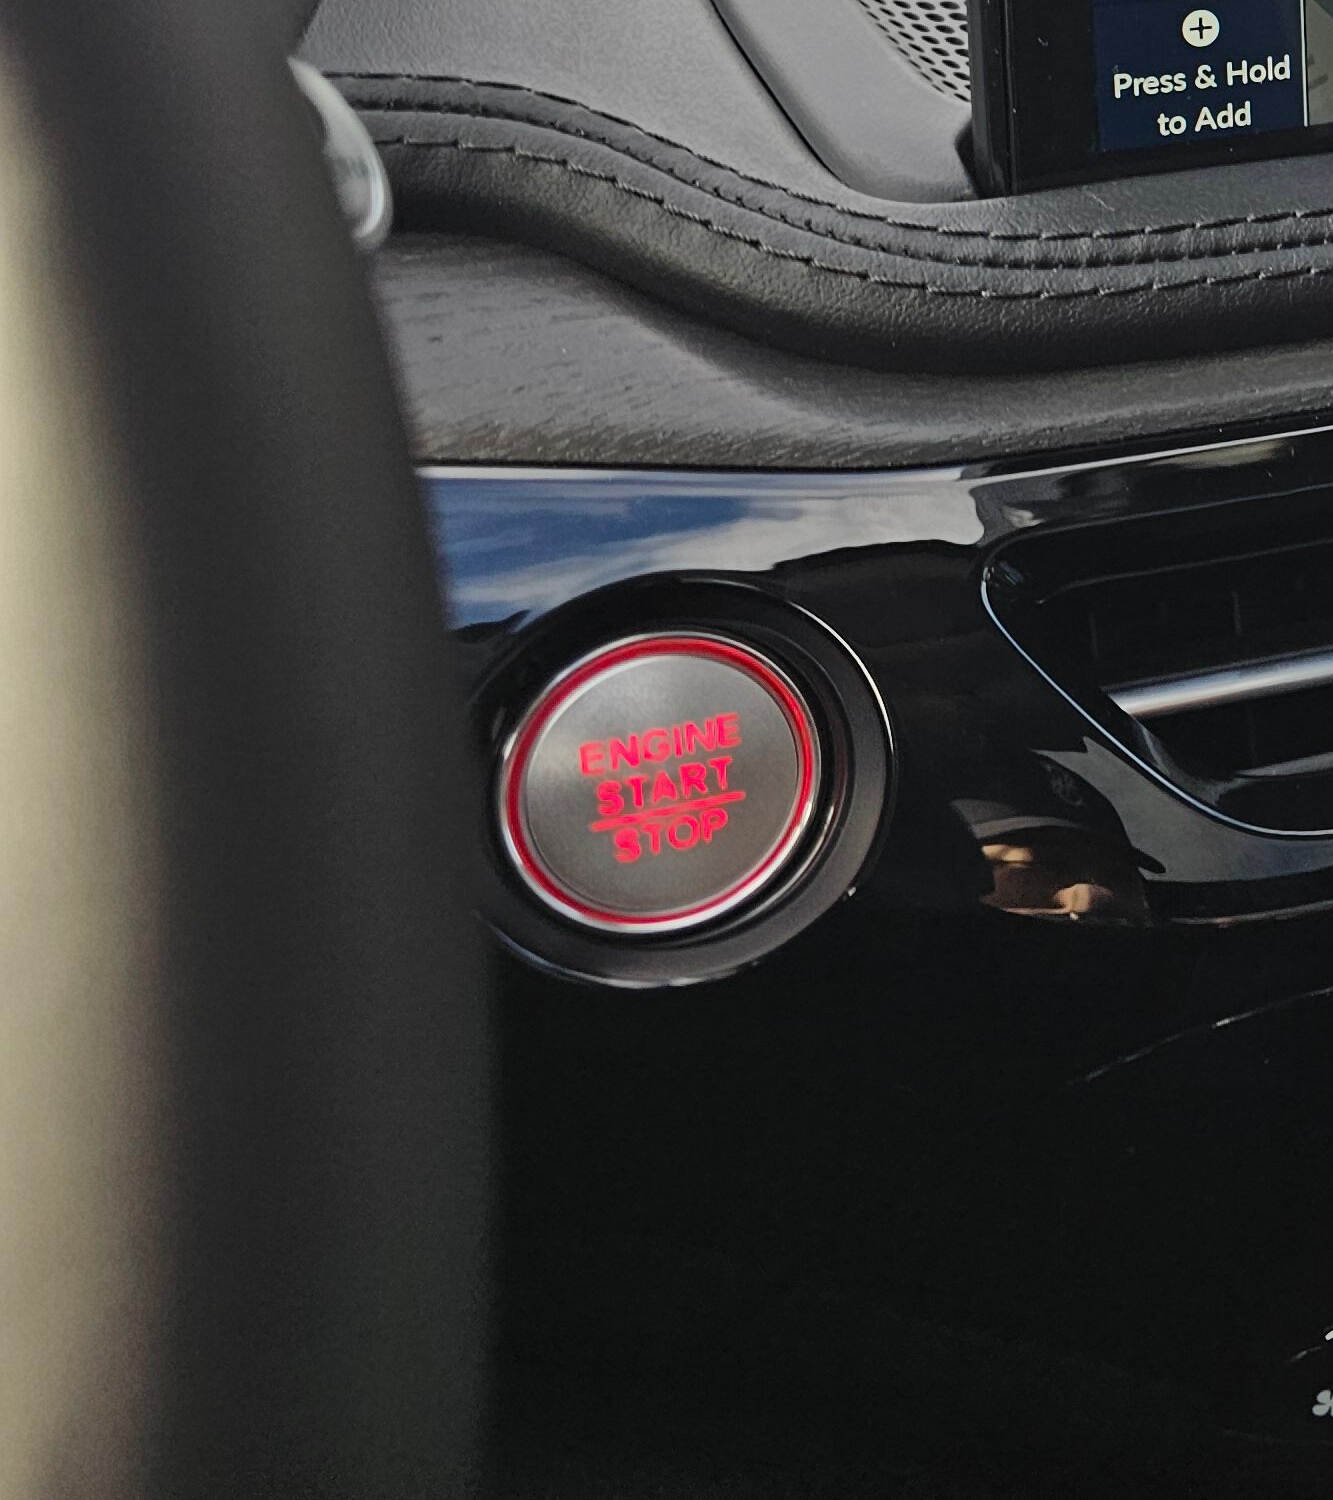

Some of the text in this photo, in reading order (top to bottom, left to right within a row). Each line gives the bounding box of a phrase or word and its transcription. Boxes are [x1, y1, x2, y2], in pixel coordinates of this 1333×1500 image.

[1113, 53, 1291, 99] Press & Hold
[1157, 100, 1252, 137] to Add
[577, 712, 743, 777] ENGINE
[596, 755, 734, 816] START
[613, 807, 729, 864] STOP
